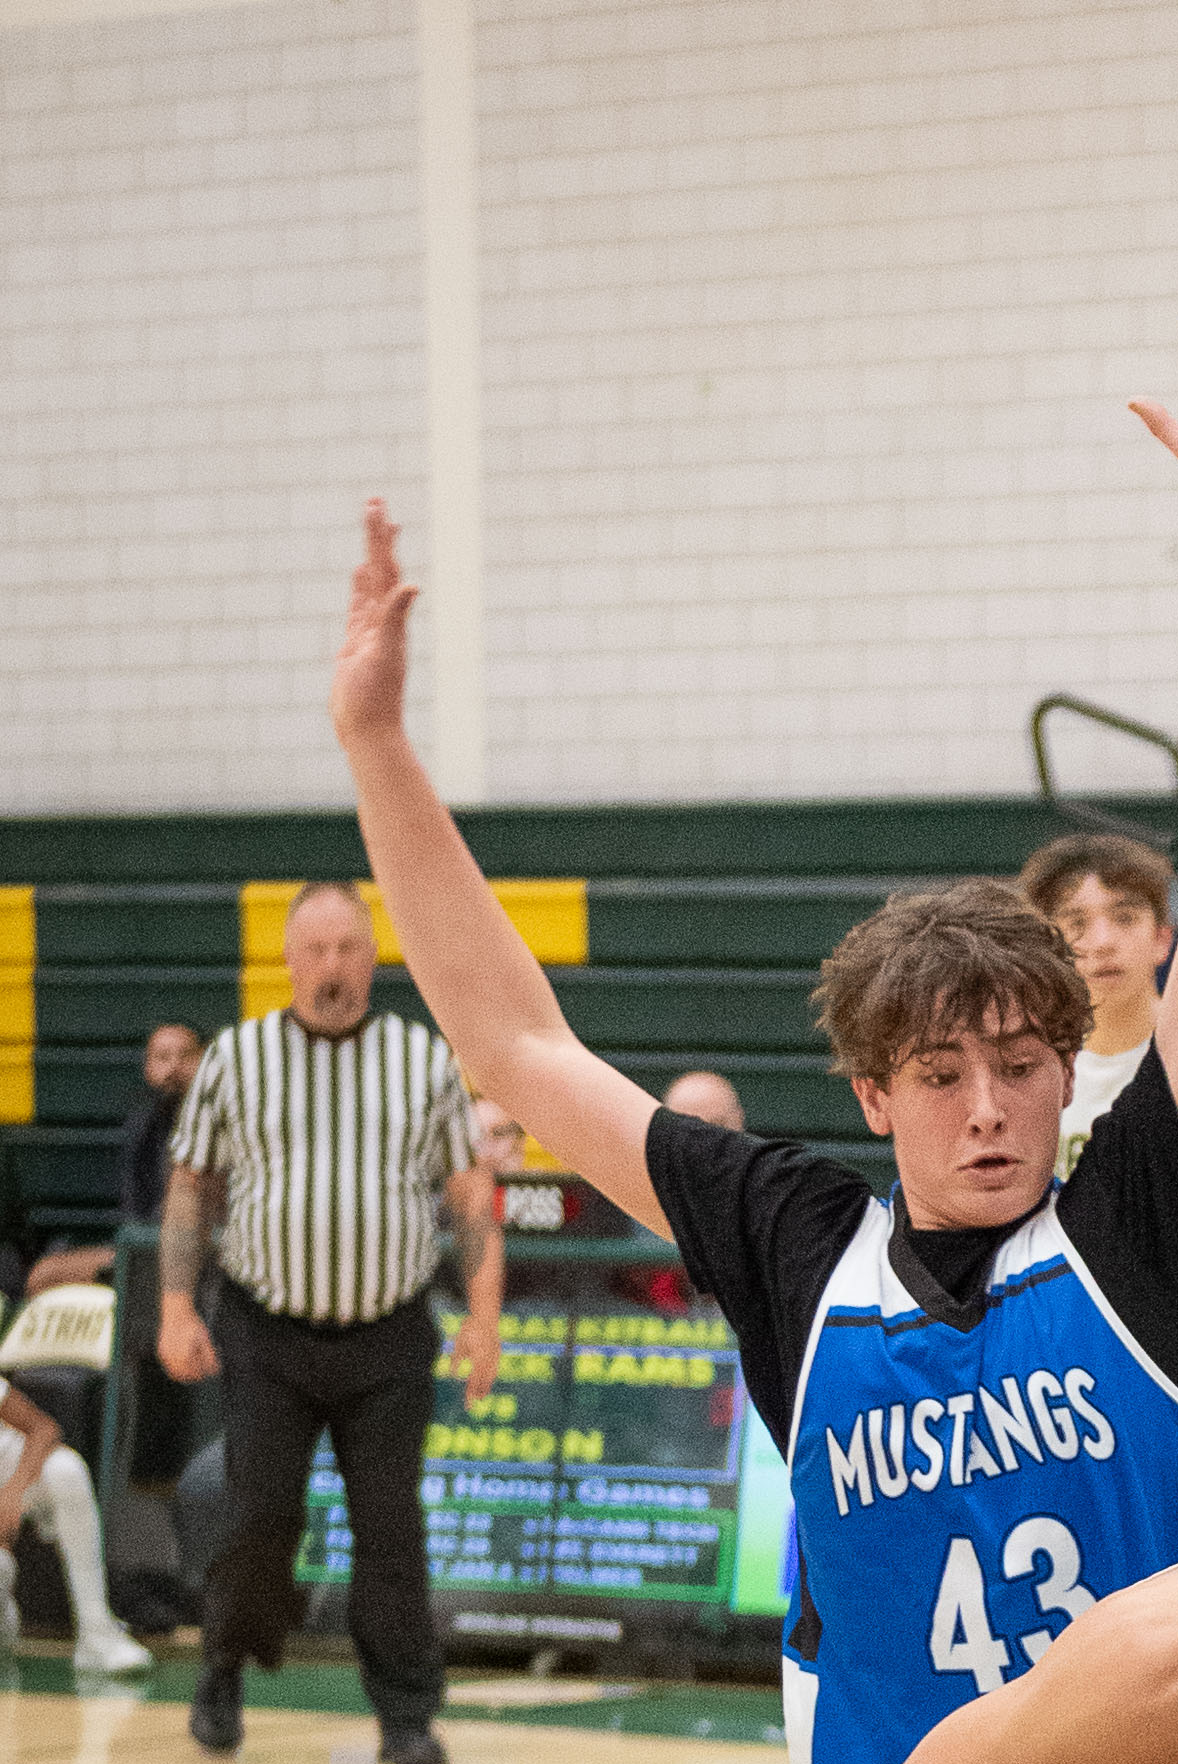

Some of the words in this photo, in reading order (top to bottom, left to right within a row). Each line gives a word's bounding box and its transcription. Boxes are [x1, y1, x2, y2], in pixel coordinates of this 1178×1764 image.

[574, 1353, 715, 1389] RAMS
[826, 1368, 1116, 1518] MUSTANGS
[930, 1515, 1098, 1694] 43
